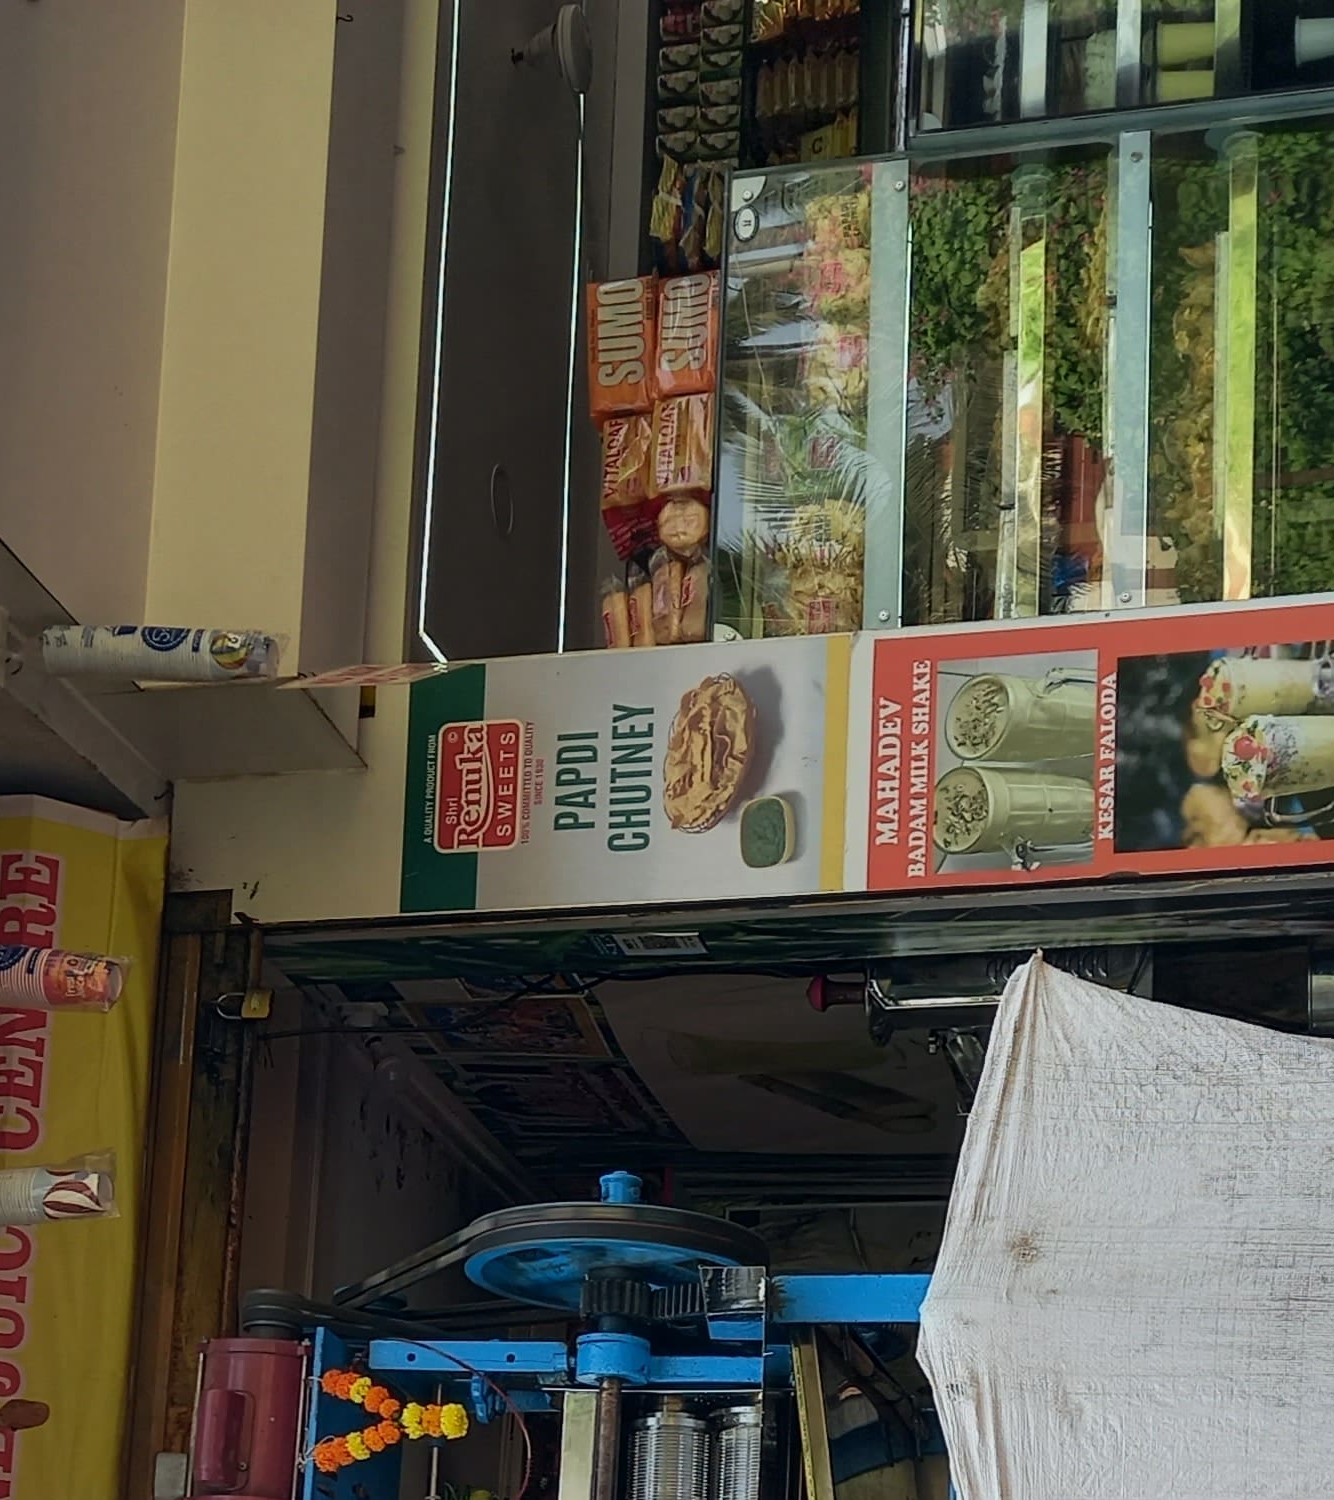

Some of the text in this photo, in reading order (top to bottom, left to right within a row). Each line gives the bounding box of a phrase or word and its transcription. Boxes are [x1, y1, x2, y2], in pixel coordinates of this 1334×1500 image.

[596, 278, 646, 386] SUMO
[660, 272, 711, 371] SUMO
[425, 761, 436, 799] PRODUCT
[426, 734, 436, 759] FROM
[456, 724, 489, 849] Renuka
[496, 732, 516, 837] SWEETS
[523, 758, 533, 769] TO
[524, 721, 535, 757] QUALITY
[553, 731, 599, 832] PAPDI
[607, 703, 655, 853] CHUTNEY
[875, 697, 903, 845] MAHADEV
[907, 659, 932, 878] BADAM MILK SHAKE
[1098, 672, 1117, 840] KESAR FALODA
[423, 800, 434, 835] QUALITY
[445, 797, 458, 825] Shri
[533, 780, 544, 805] SINCE
